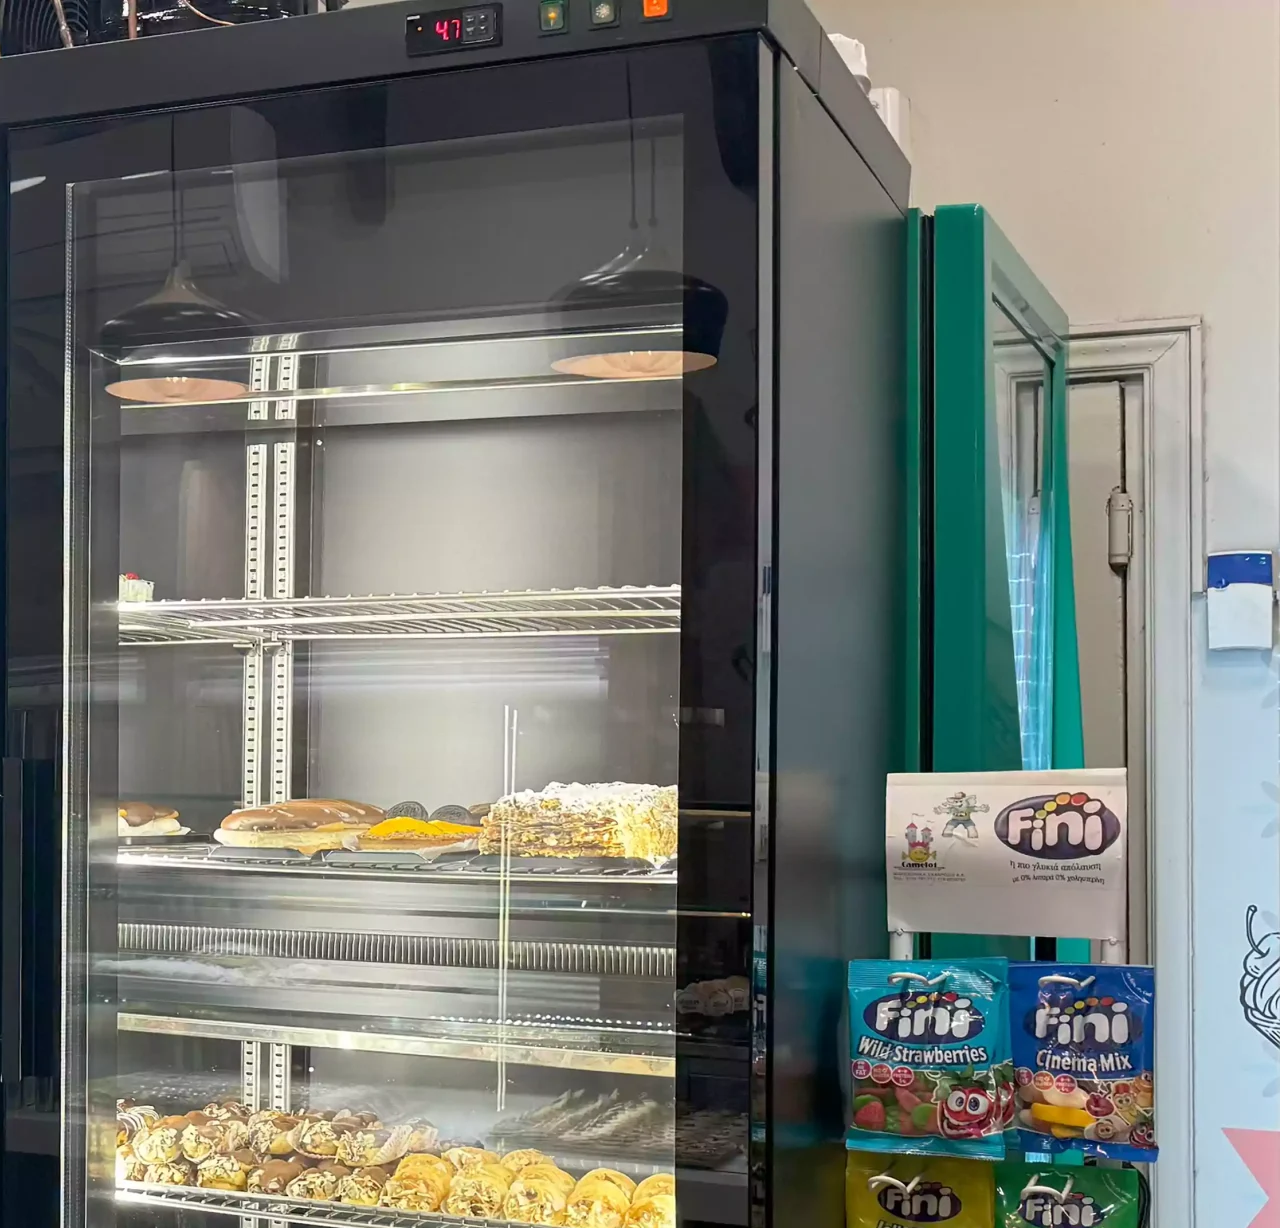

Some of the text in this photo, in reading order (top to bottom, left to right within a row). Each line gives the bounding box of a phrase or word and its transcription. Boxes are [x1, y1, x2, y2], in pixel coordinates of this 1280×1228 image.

[1007, 800, 1102, 851] Fini
[901, 861, 937, 869] Camelot
[1032, 861, 1059, 872] γλυκιά
[1060, 861, 1102, 871] απόλαυση
[876, 998, 971, 1038] Fini
[1035, 1002, 1128, 1045] Fini
[859, 1036, 988, 1064] Wild Strawberries
[1036, 1049, 1133, 1072] Cinema Mix
[886, 1187, 952, 1218] Fini
[1025, 1197, 1094, 1227] Fini
